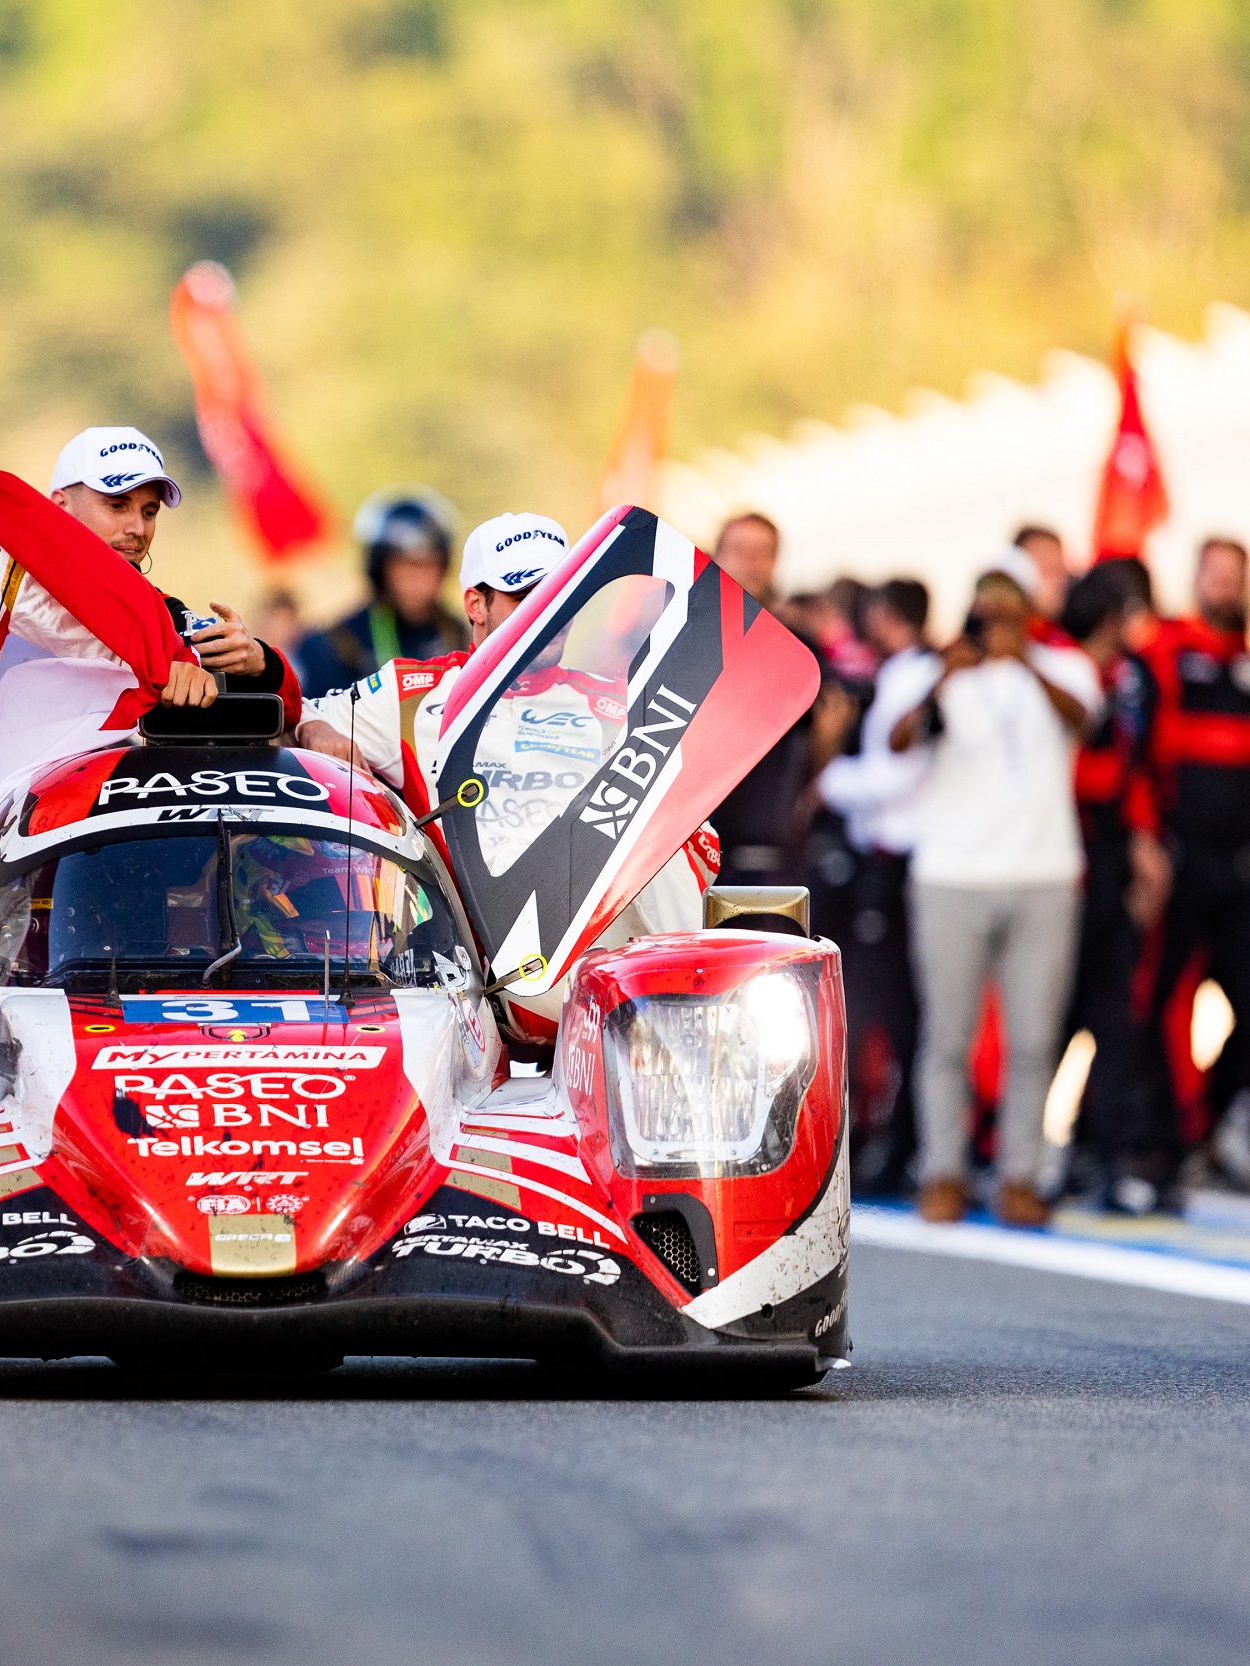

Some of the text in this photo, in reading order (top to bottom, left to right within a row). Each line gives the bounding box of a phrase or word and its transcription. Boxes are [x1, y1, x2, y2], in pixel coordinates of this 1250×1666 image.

[402, 674, 435, 687] OMP
[596, 698, 627, 717] OMP
[521, 709, 593, 728] WEC
[608, 684, 697, 790] BNI
[98, 771, 330, 806] PASEO
[162, 1000, 310, 1021] 31
[573, 1047, 596, 1096] BNI
[114, 1073, 346, 1099] PASEO
[213, 1103, 330, 1128] BNI
[127, 1136, 363, 1157] Telkomsel
[185, 1172, 309, 1186] WRT
[201, 1198, 245, 1211] FIA
[2, 1211, 76, 1226] BELL
[394, 1234, 529, 1250] PERTAMAX
[448, 1214, 611, 1250] TACO BELL
[392, 1240, 586, 1275] TURBO
